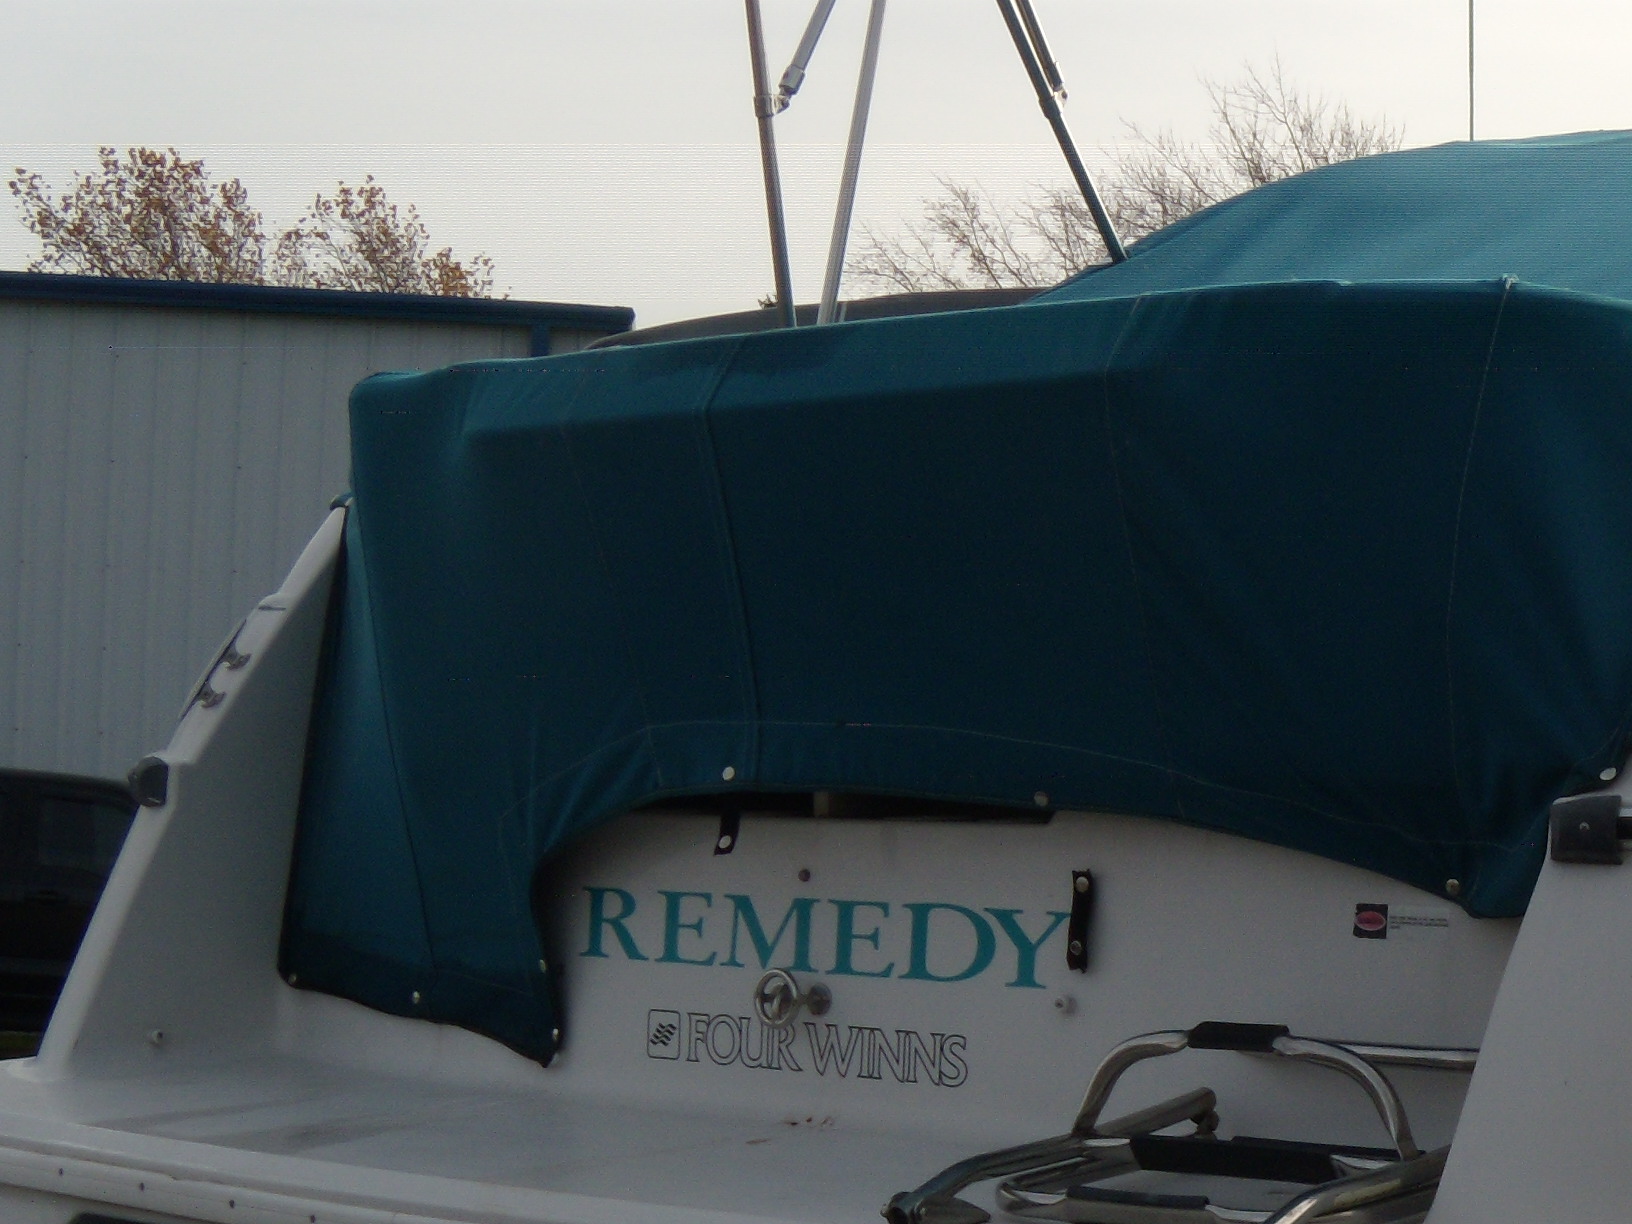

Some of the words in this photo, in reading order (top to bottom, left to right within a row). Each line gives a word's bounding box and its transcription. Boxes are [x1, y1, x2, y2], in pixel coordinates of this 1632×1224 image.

[580, 886, 1071, 989] REMEDY
[687, 1012, 803, 1072] FOUR
[803, 1021, 969, 1088] WINNS
